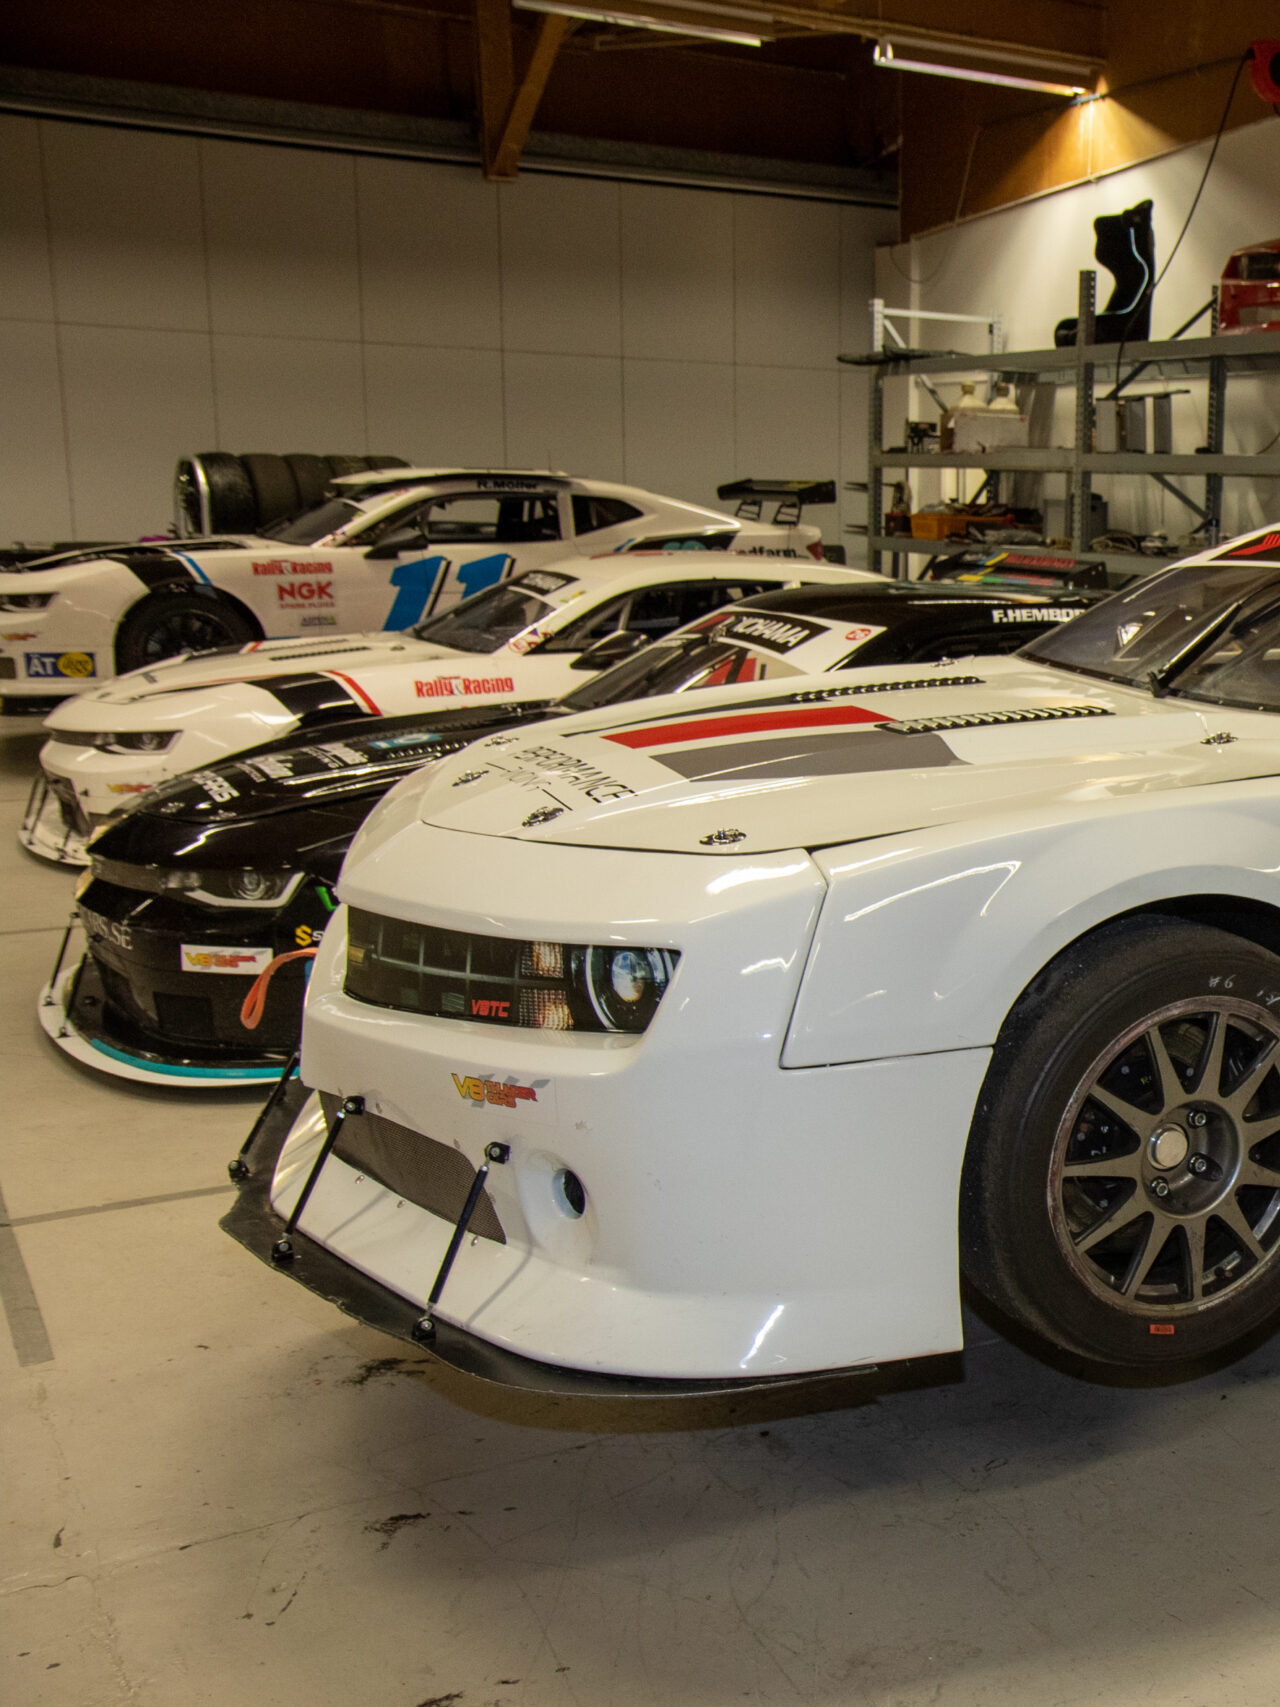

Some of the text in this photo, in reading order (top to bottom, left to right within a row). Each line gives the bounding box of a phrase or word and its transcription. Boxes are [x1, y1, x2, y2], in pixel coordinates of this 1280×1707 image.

[277, 581, 334, 601] NGK
[414, 680, 454, 698] Rally
[462, 677, 515, 696] Racing
[450, 1072, 485, 1102] V8
